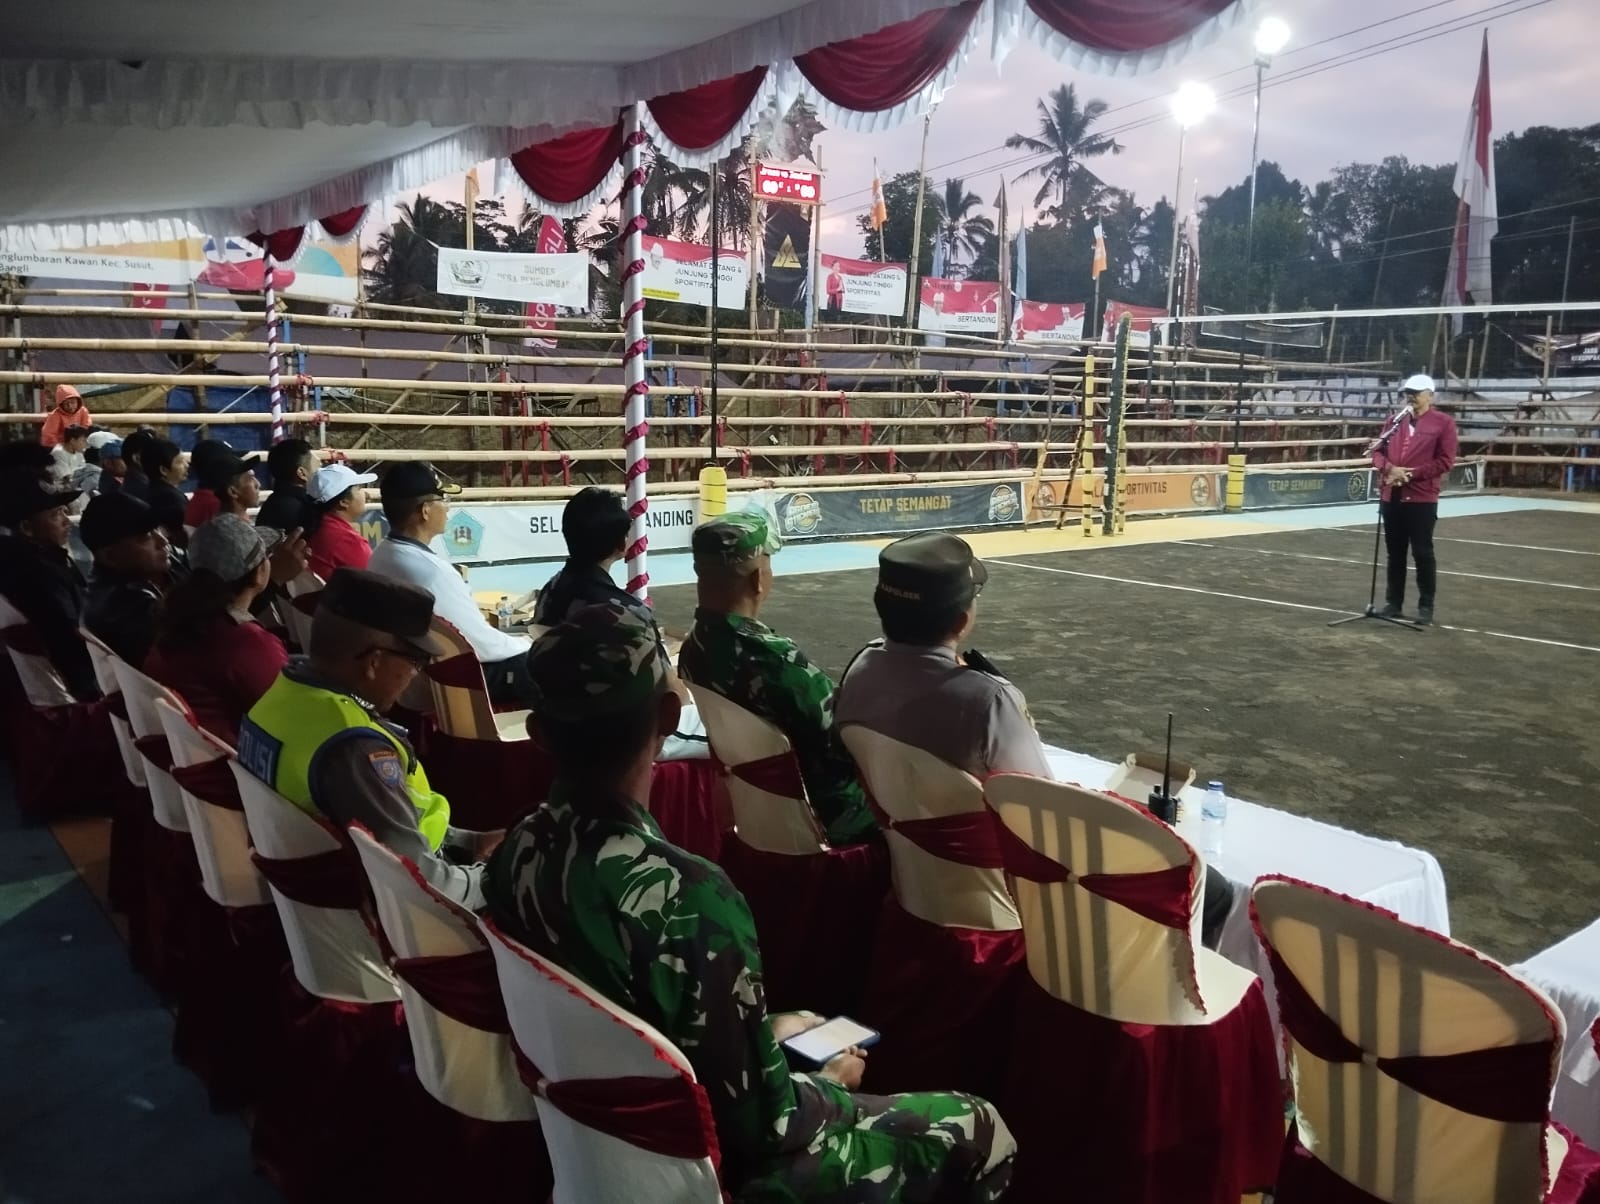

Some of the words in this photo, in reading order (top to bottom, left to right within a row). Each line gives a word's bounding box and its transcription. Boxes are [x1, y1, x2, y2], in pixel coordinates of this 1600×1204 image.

[0, 252, 62, 264] nglumbaran
[65, 255, 98, 266] Kawan
[675, 268, 708, 278] JUNJUNG
[709, 273, 733, 281] TNGGI
[709, 263, 736, 272] DTANG
[674, 278, 717, 288] SPORTIFITA
[957, 315, 997, 324] BERTANDING
[1117, 481, 1167, 497] ORTIVITAS
[860, 498, 893, 514] TETAP
[896, 495, 952, 512] SEMANGAT
[645, 510, 694, 528] ANDING
[239, 722, 273, 785] OLISI
